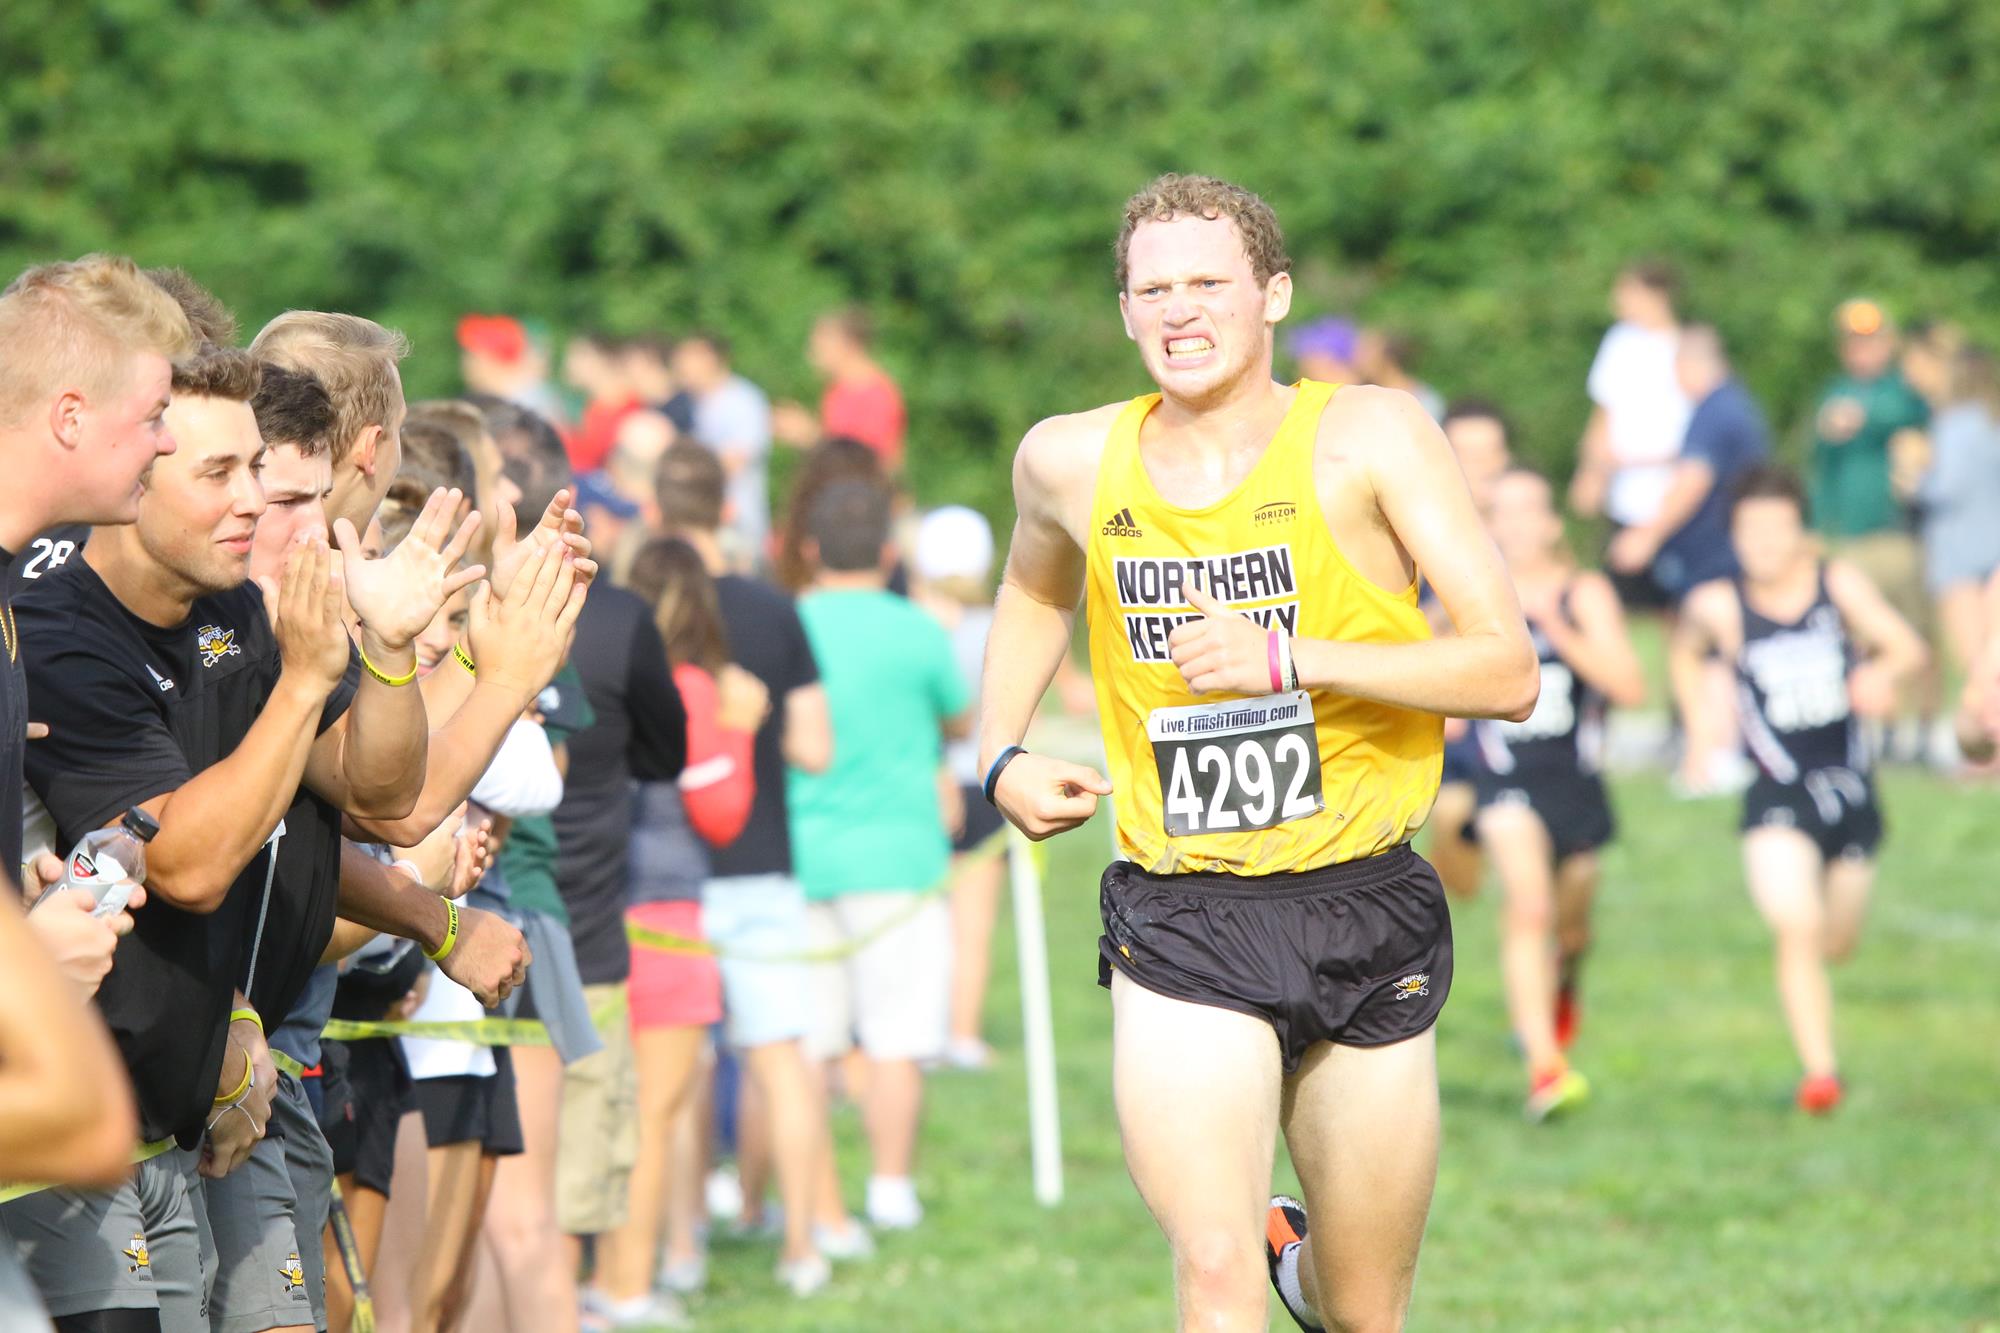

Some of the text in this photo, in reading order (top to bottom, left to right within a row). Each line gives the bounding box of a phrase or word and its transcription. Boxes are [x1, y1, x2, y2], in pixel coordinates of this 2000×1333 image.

[1254, 507, 1296, 521] HORIZON
[1102, 526, 1142, 537] adidas
[1117, 548, 1293, 604] NORTHERN
[1160, 704, 1298, 734] Live.FinishTiming.com
[1167, 733, 1316, 830] 4292
